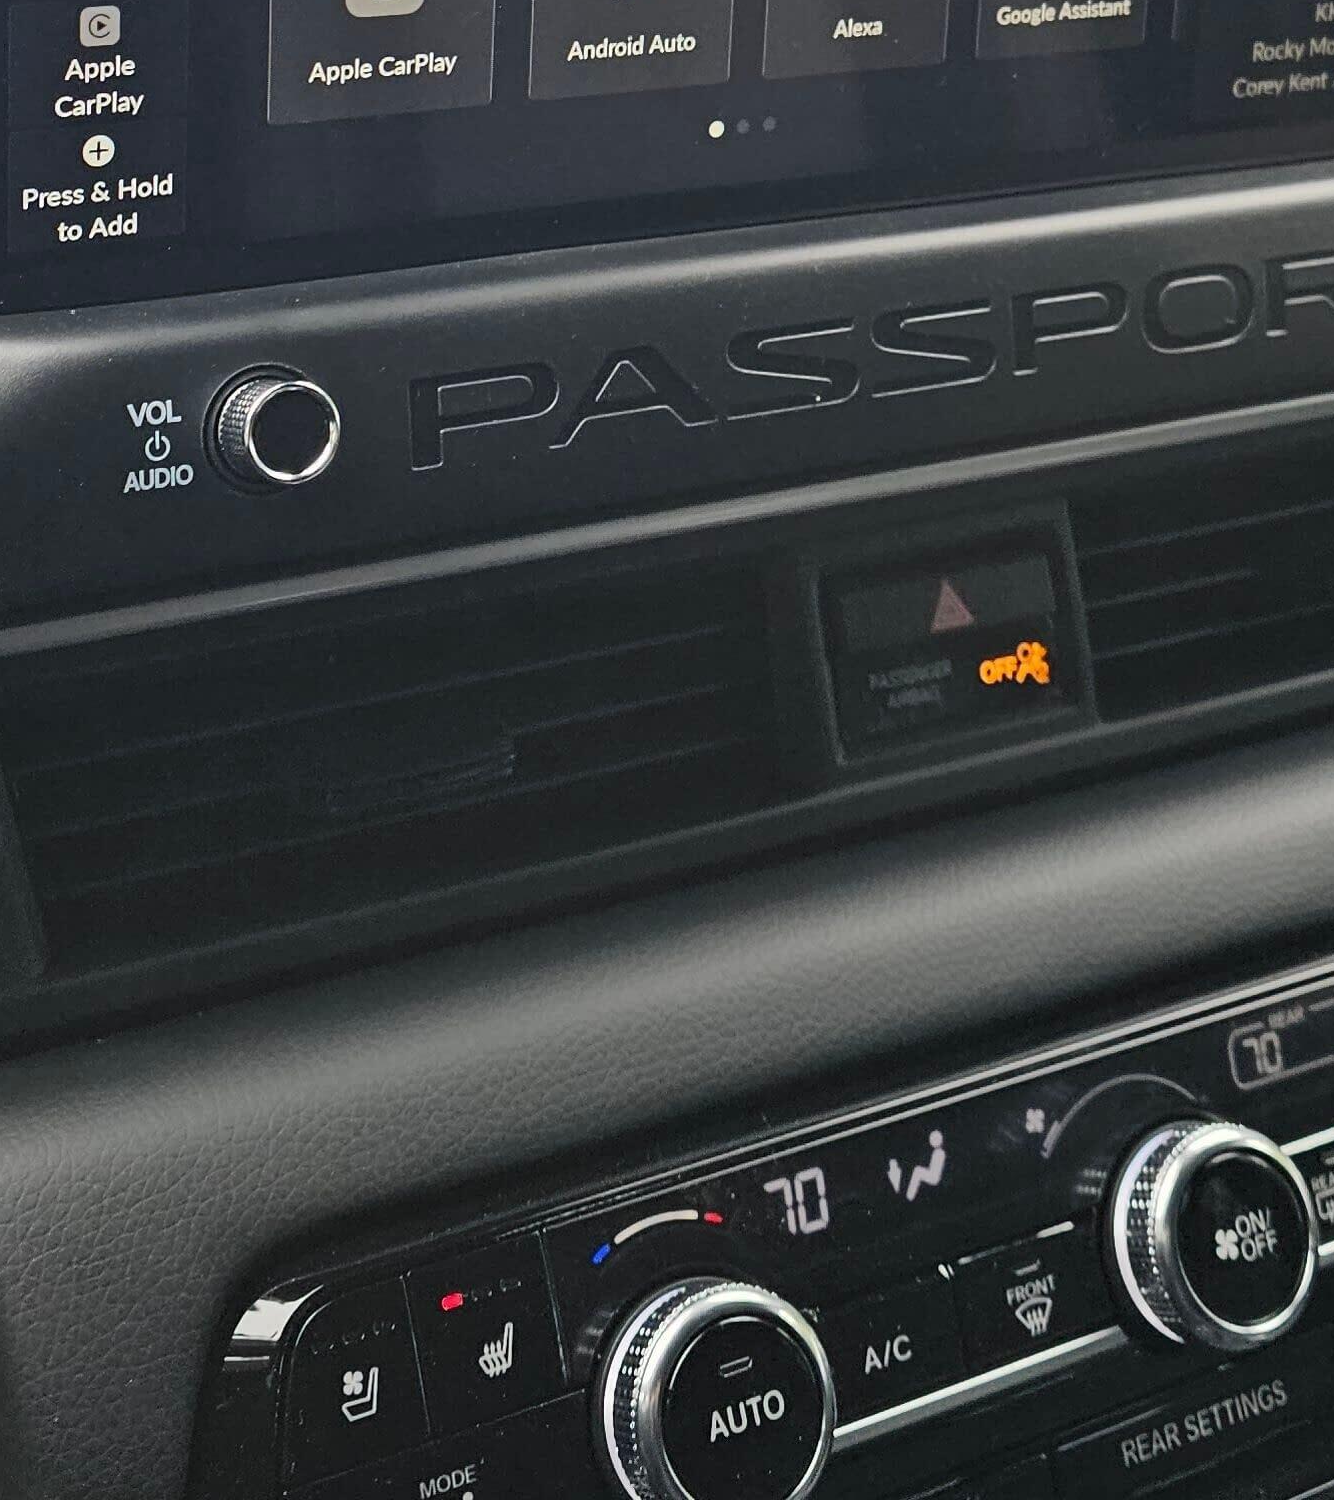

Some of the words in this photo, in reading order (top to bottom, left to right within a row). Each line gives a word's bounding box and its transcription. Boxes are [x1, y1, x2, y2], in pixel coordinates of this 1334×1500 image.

[833, 18, 883, 38] Alexa
[996, 2, 1055, 26] Google
[568, 37, 644, 61] Android
[649, 32, 696, 55] Auto
[1252, 39, 1305, 63] Rocky
[64, 56, 136, 84] Apple
[308, 57, 373, 84] Apple
[378, 53, 458, 79] CarPlay
[1232, 74, 1285, 97] Corey
[1289, 71, 1328, 92] Kent
[54, 90, 144, 119] CarPlay
[22, 186, 85, 210] Press
[91, 182, 111, 203] &
[118, 174, 173, 200] Hold
[57, 221, 84, 242] to
[90, 214, 138, 238] Add
[127, 400, 181, 427] VOL
[123, 464, 194, 493] AUDIO
[1242, 1030, 1283, 1075] 70
[764, 1168, 829, 1235] 70
[1241, 1232, 1279, 1263] OFF
[1006, 1274, 1057, 1306] FRONT
[864, 1335, 913, 1375] A/C
[708, 1389, 786, 1443] AUTO
[1120, 1421, 1183, 1467] REAR
[1182, 1379, 1289, 1444] SETTINGS
[419, 1463, 478, 1499] MODE
